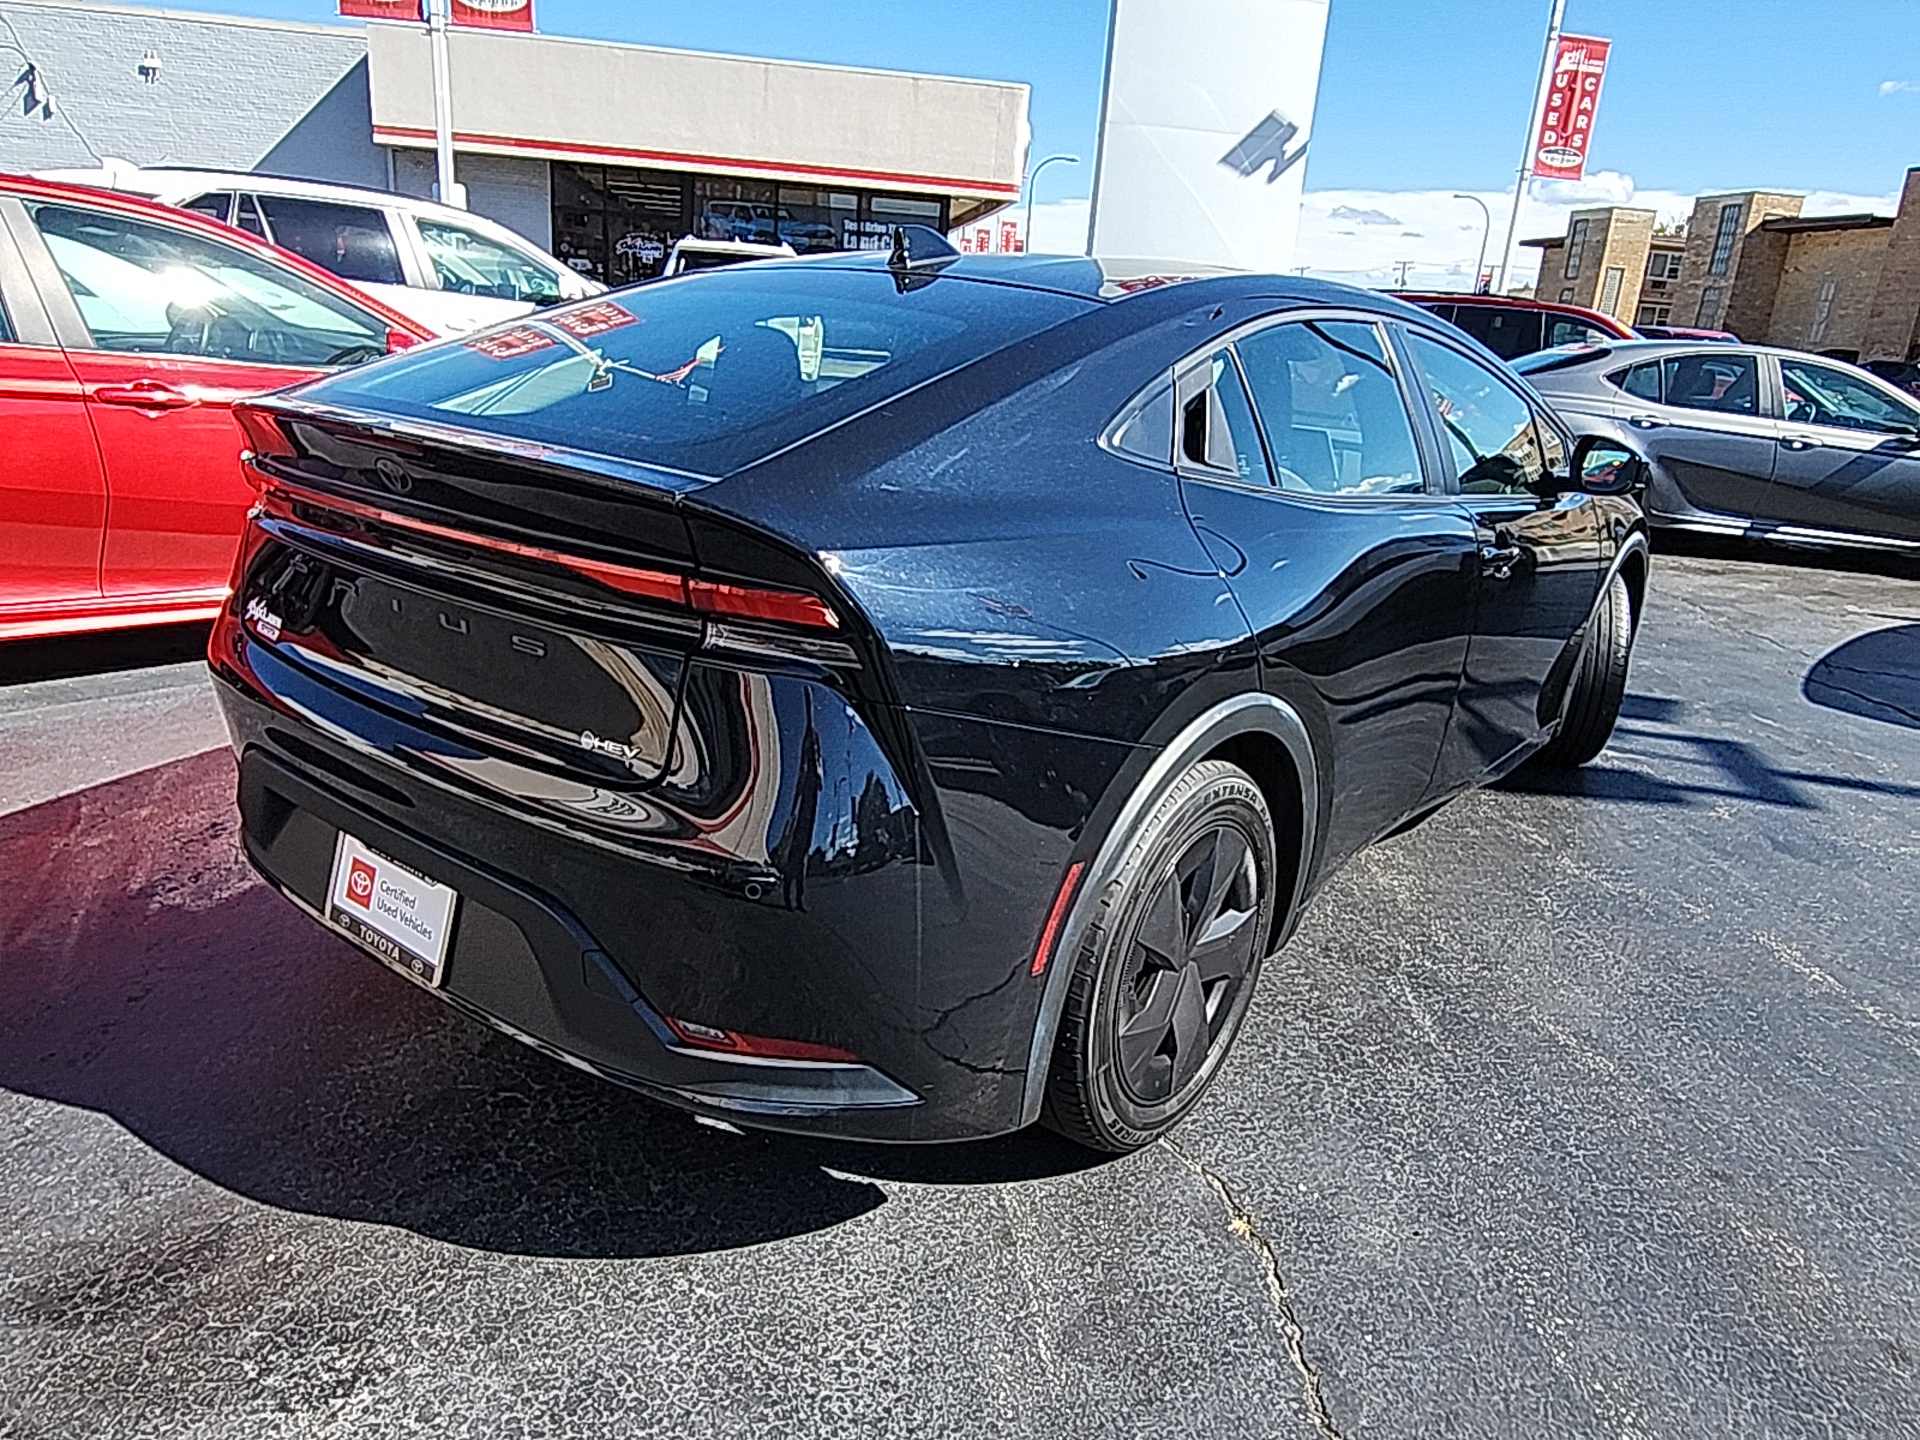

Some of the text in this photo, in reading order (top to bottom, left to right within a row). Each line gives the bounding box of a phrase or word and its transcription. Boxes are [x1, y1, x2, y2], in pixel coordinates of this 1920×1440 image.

[1543, 73, 1568, 145] USED
[1571, 77, 1597, 147] CARS
[843, 219, 865, 231] Test
[865, 221, 887, 233] Drive
[843, 232, 879, 250] Land
[593, 736, 641, 759] HEV
[1203, 785, 1257, 806] EXTENSA
[379, 879, 417, 910] Certified
[376, 896, 433, 941] Used Vehicles
[358, 924, 401, 962] TOYOTA
